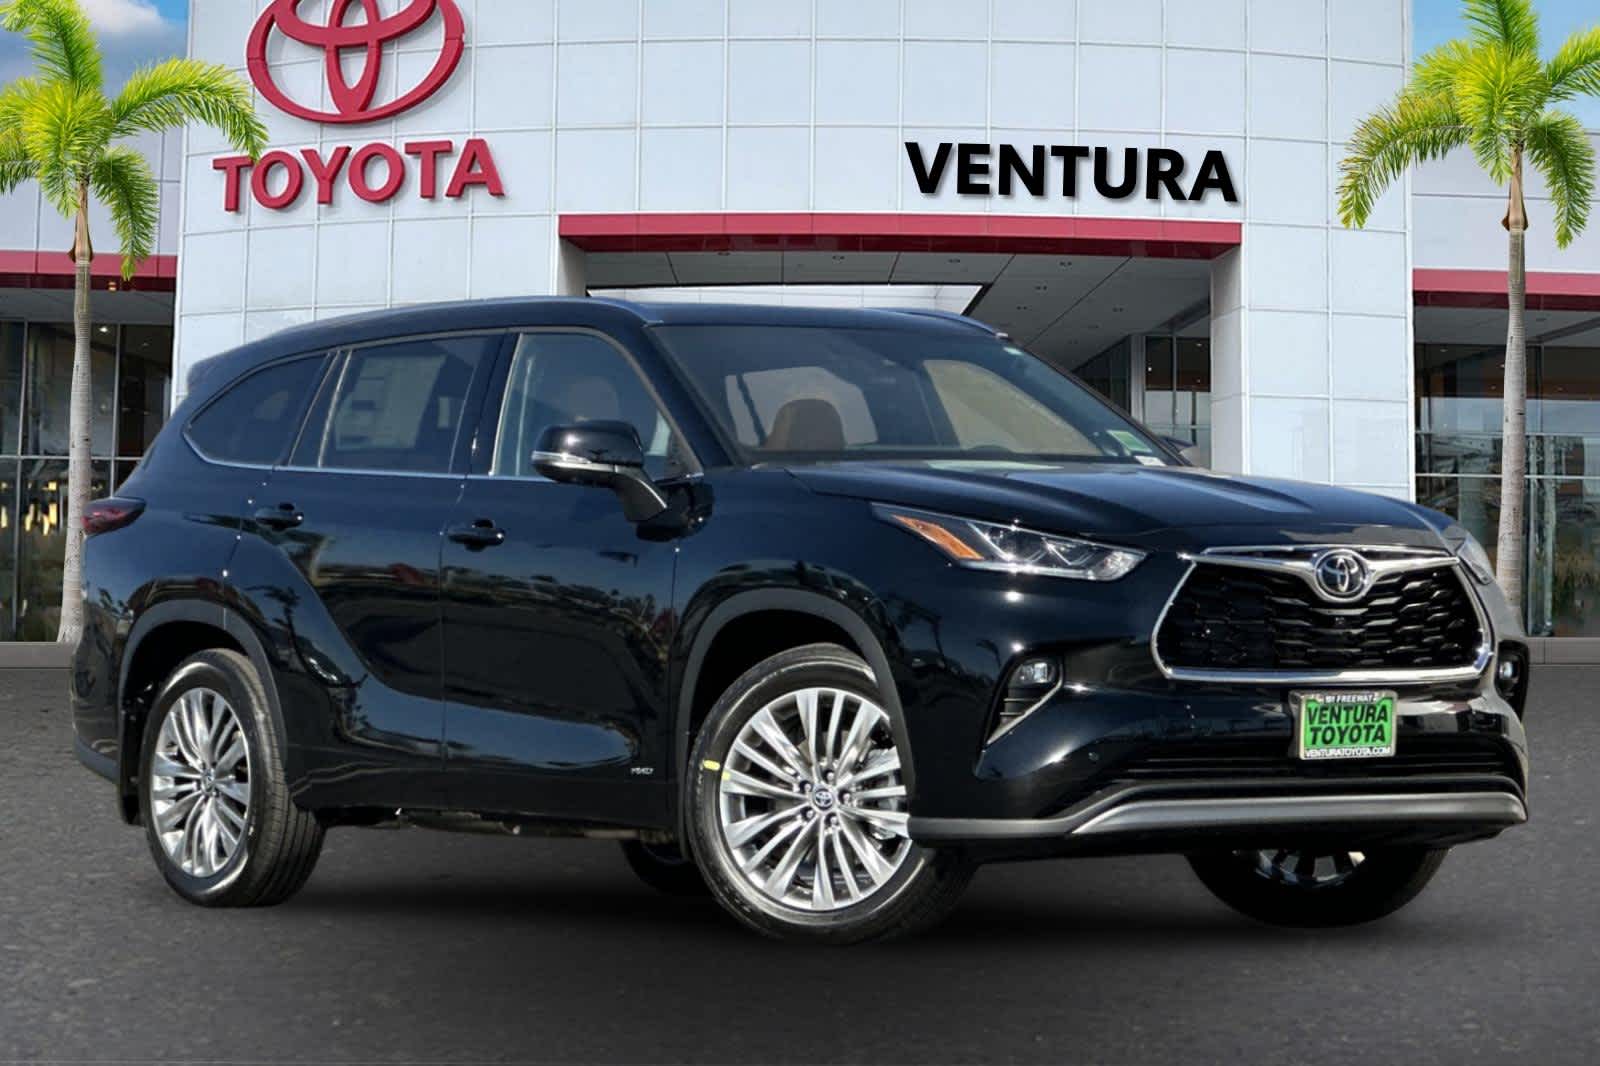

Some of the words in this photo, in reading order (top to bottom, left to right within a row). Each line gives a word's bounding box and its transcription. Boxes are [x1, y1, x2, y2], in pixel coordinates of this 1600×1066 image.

[213, 138, 505, 212] TOYOTA
[904, 141, 1239, 203] VENTURA
[1308, 705, 1388, 724] VENTURA
[1309, 724, 1386, 745] TOYOTA
[1306, 747, 1390, 757] VENTURATOYOTA.COM
